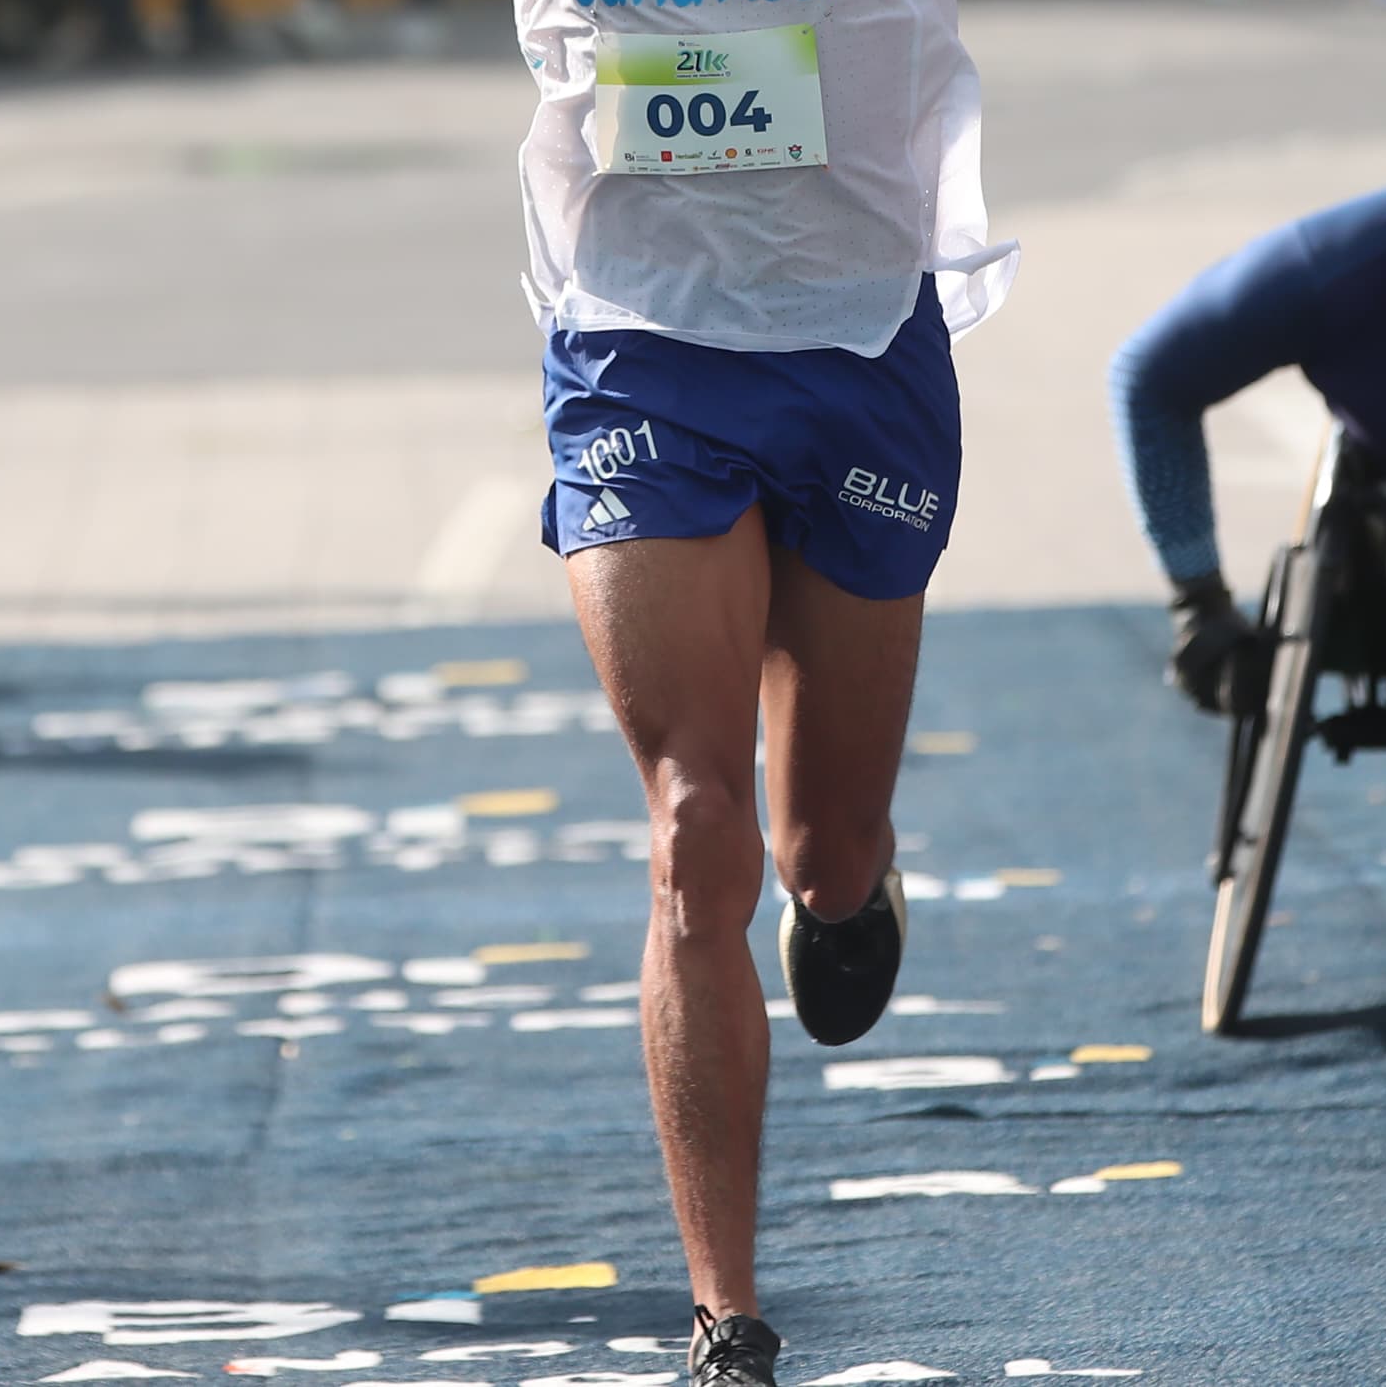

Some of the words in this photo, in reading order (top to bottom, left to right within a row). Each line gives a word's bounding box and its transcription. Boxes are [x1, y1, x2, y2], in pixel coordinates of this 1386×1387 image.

[646, 89, 773, 138] 004
[838, 490, 930, 532] CORPORATION
[843, 467, 939, 520] BLUE
